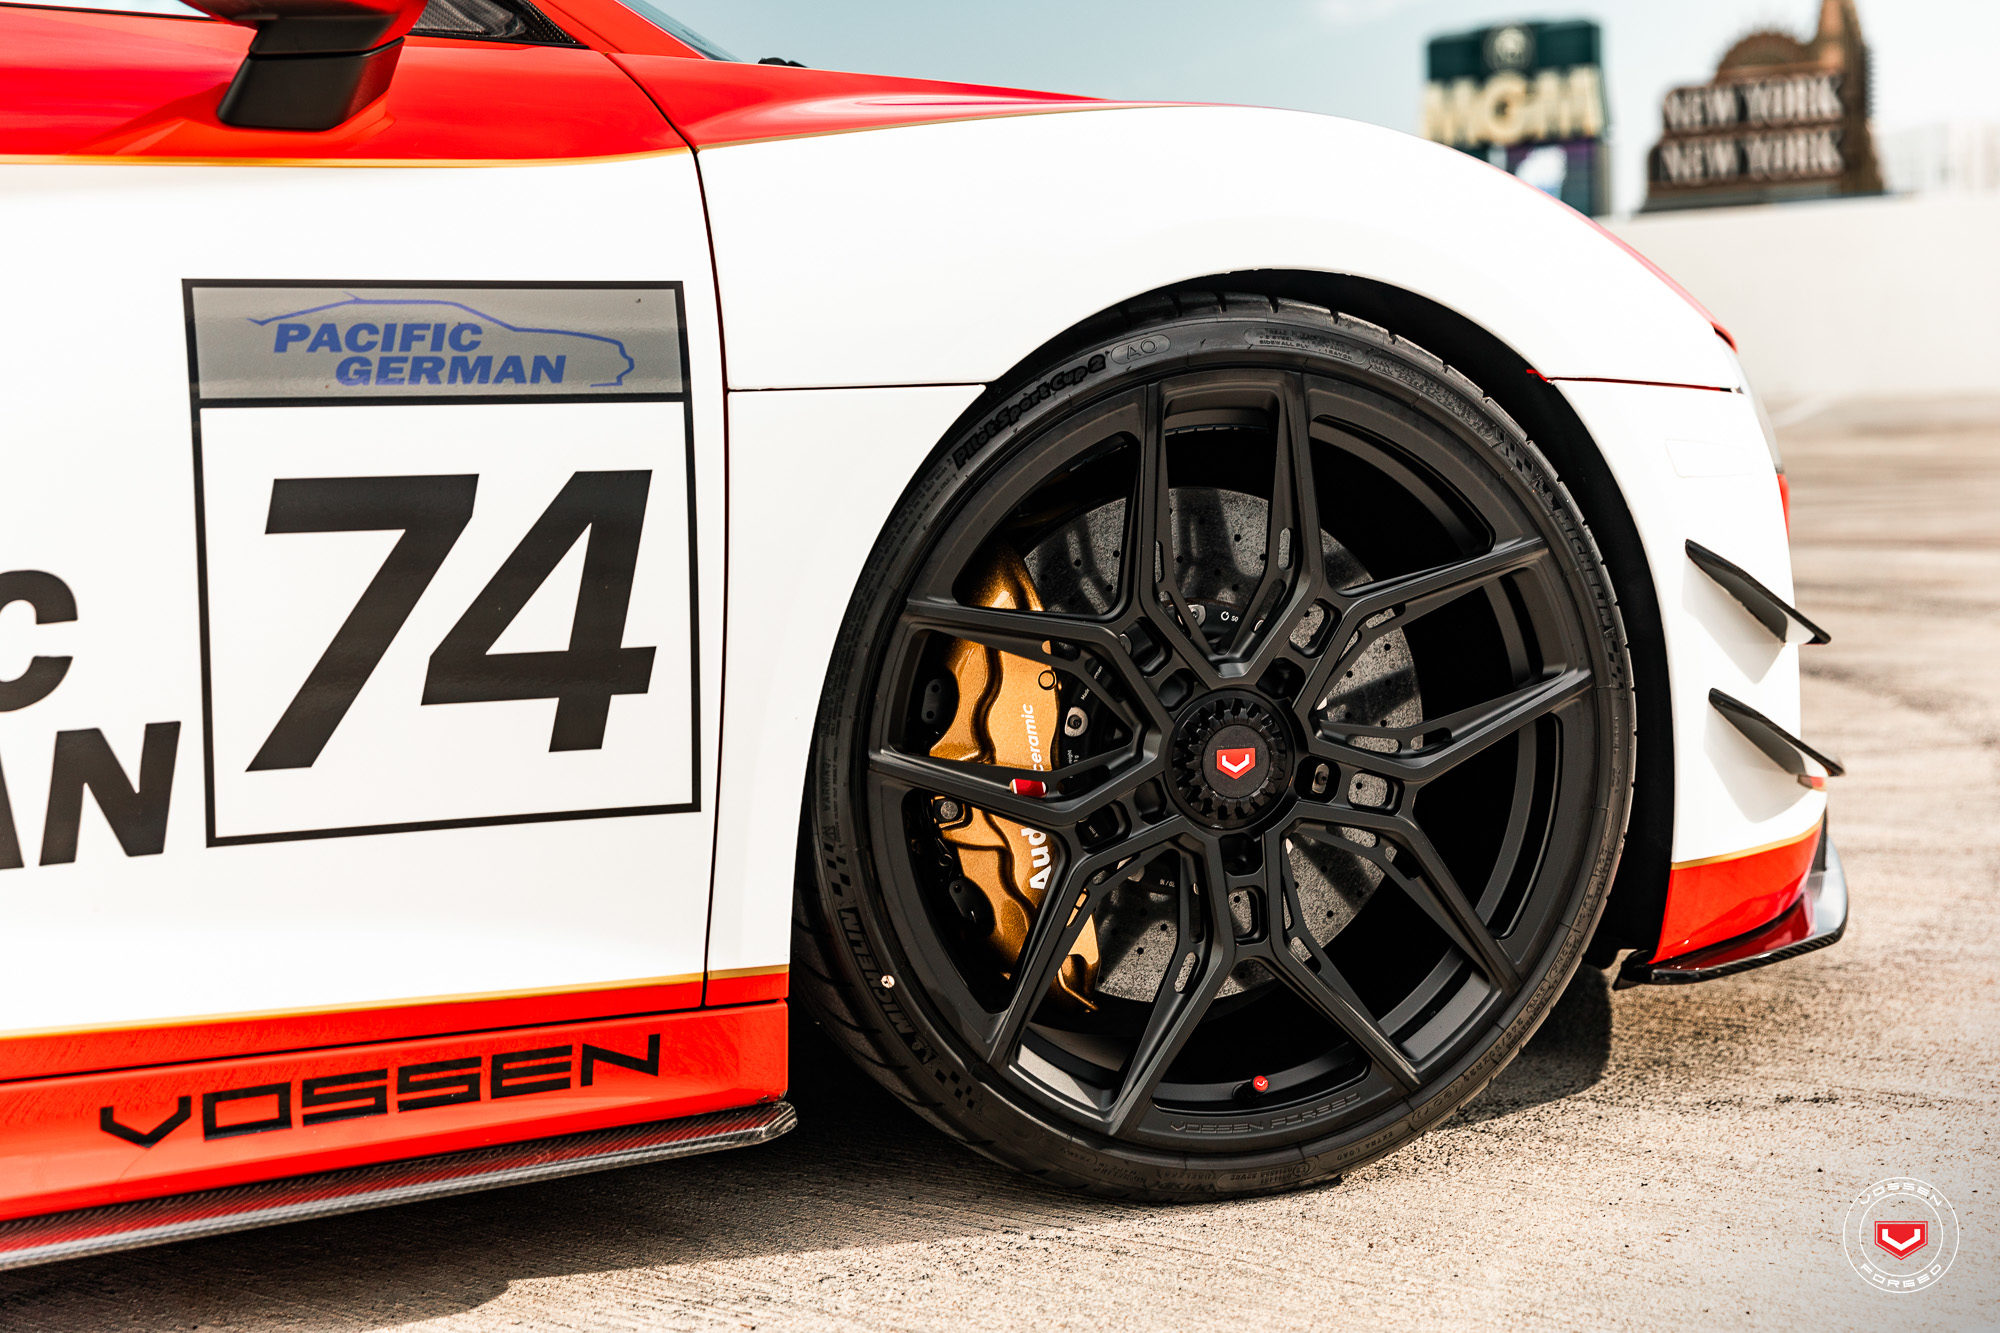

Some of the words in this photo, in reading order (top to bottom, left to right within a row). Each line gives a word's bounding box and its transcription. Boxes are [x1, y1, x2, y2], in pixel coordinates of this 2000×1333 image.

[1424, 65, 1602, 146] MGM
[1666, 86, 1738, 132] NEW
[1744, 73, 1844, 127] YORK
[1660, 139, 1738, 186] NEW
[1744, 128, 1844, 180] YORK
[273, 322, 484, 354] PACIFIC
[1126, 339, 1158, 360] AO
[335, 355, 567, 386] GERMAN
[995, 382, 1051, 427] Sport
[1050, 364, 1089, 392] Cup
[245, 469, 657, 772] 74
[1021, 827, 1052, 890] Aud
[838, 908, 916, 1035] MICHELIN
[99, 1034, 660, 1149] VOSSEN
[1170, 1120, 1264, 1134] VOSSEN
